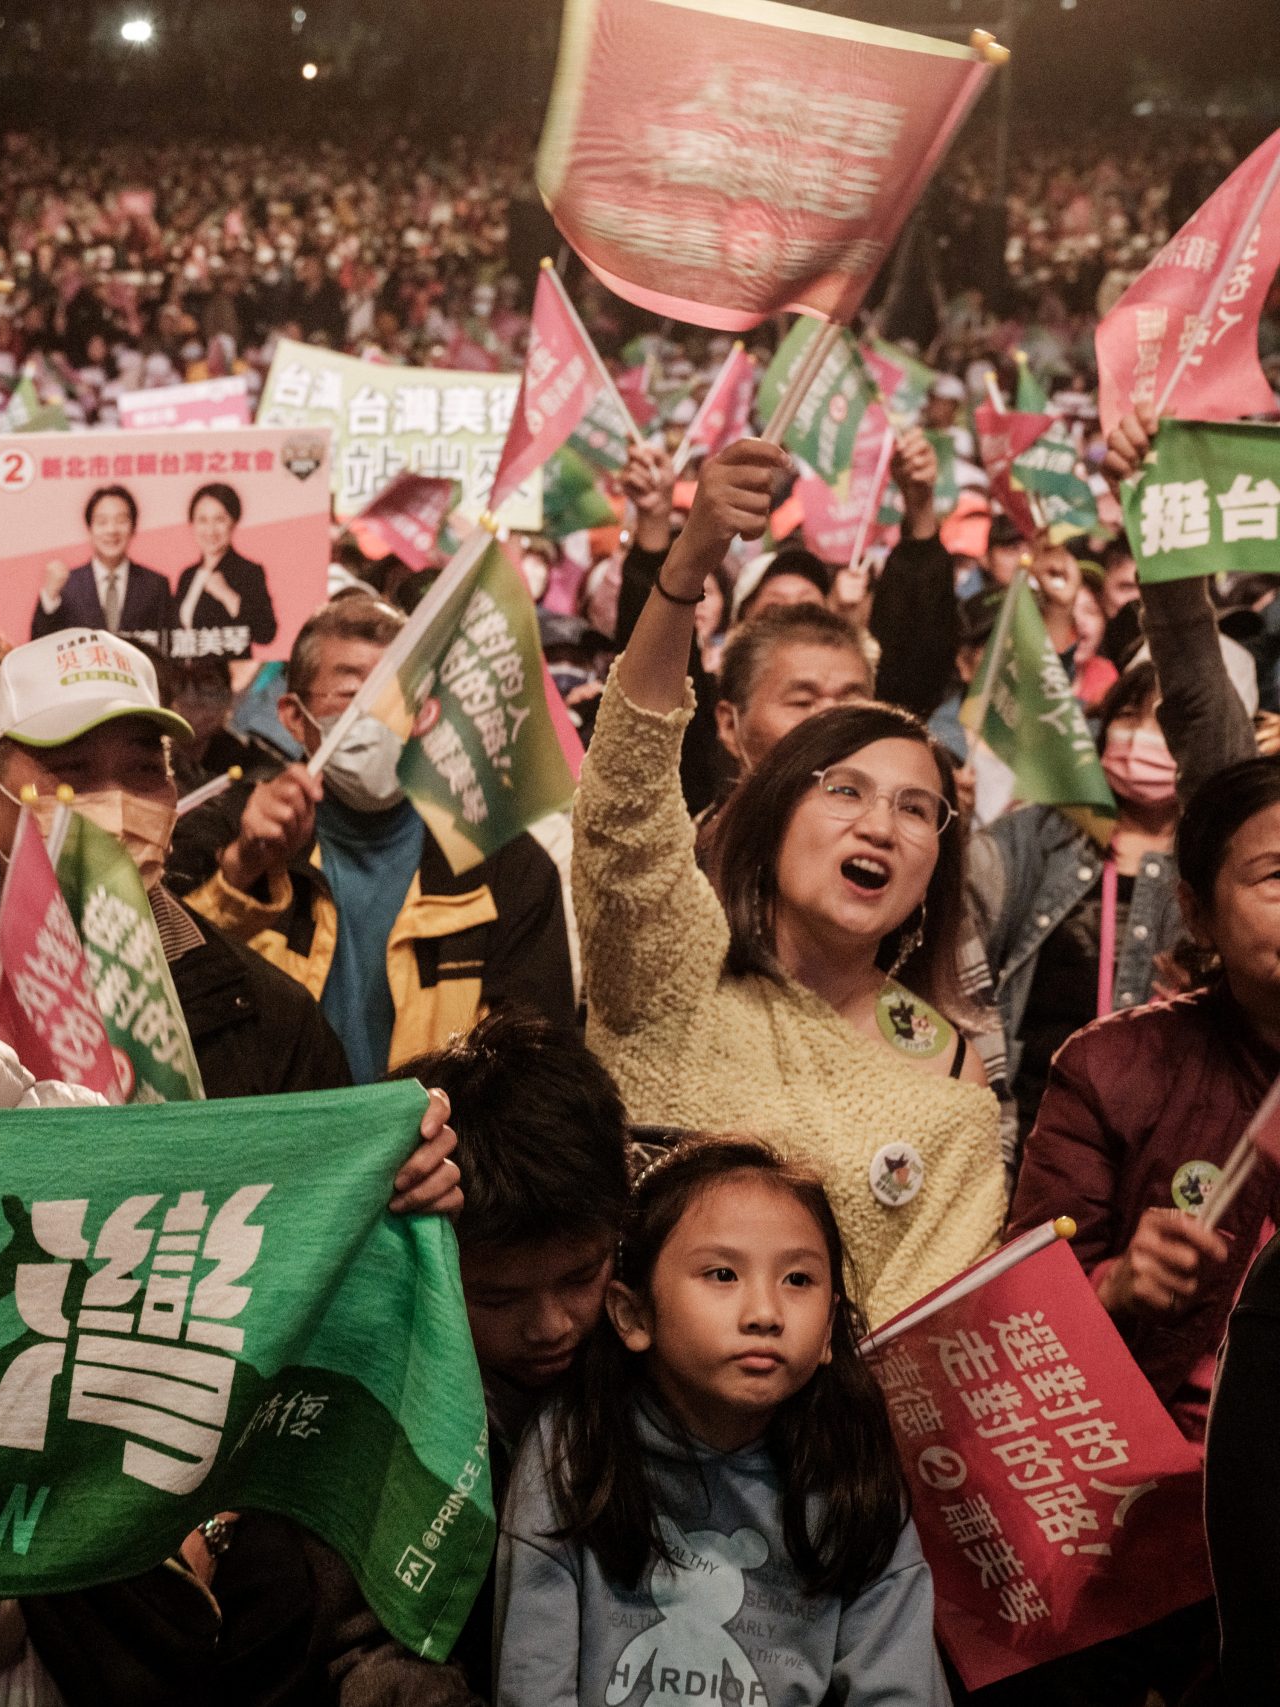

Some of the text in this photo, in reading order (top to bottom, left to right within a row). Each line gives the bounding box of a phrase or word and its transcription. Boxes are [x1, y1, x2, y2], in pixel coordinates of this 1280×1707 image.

[4, 453, 25, 483] 2
[1140, 474, 1280, 557] 挺台
[927, 1328, 1113, 1557] 走對的路!
[989, 1310, 1158, 1527] 選對的人
[421, 1460, 482, 1550] @PRINCE
[667, 1545, 720, 1576] ALTHY
[940, 1493, 1051, 1626] 蕭美琴
